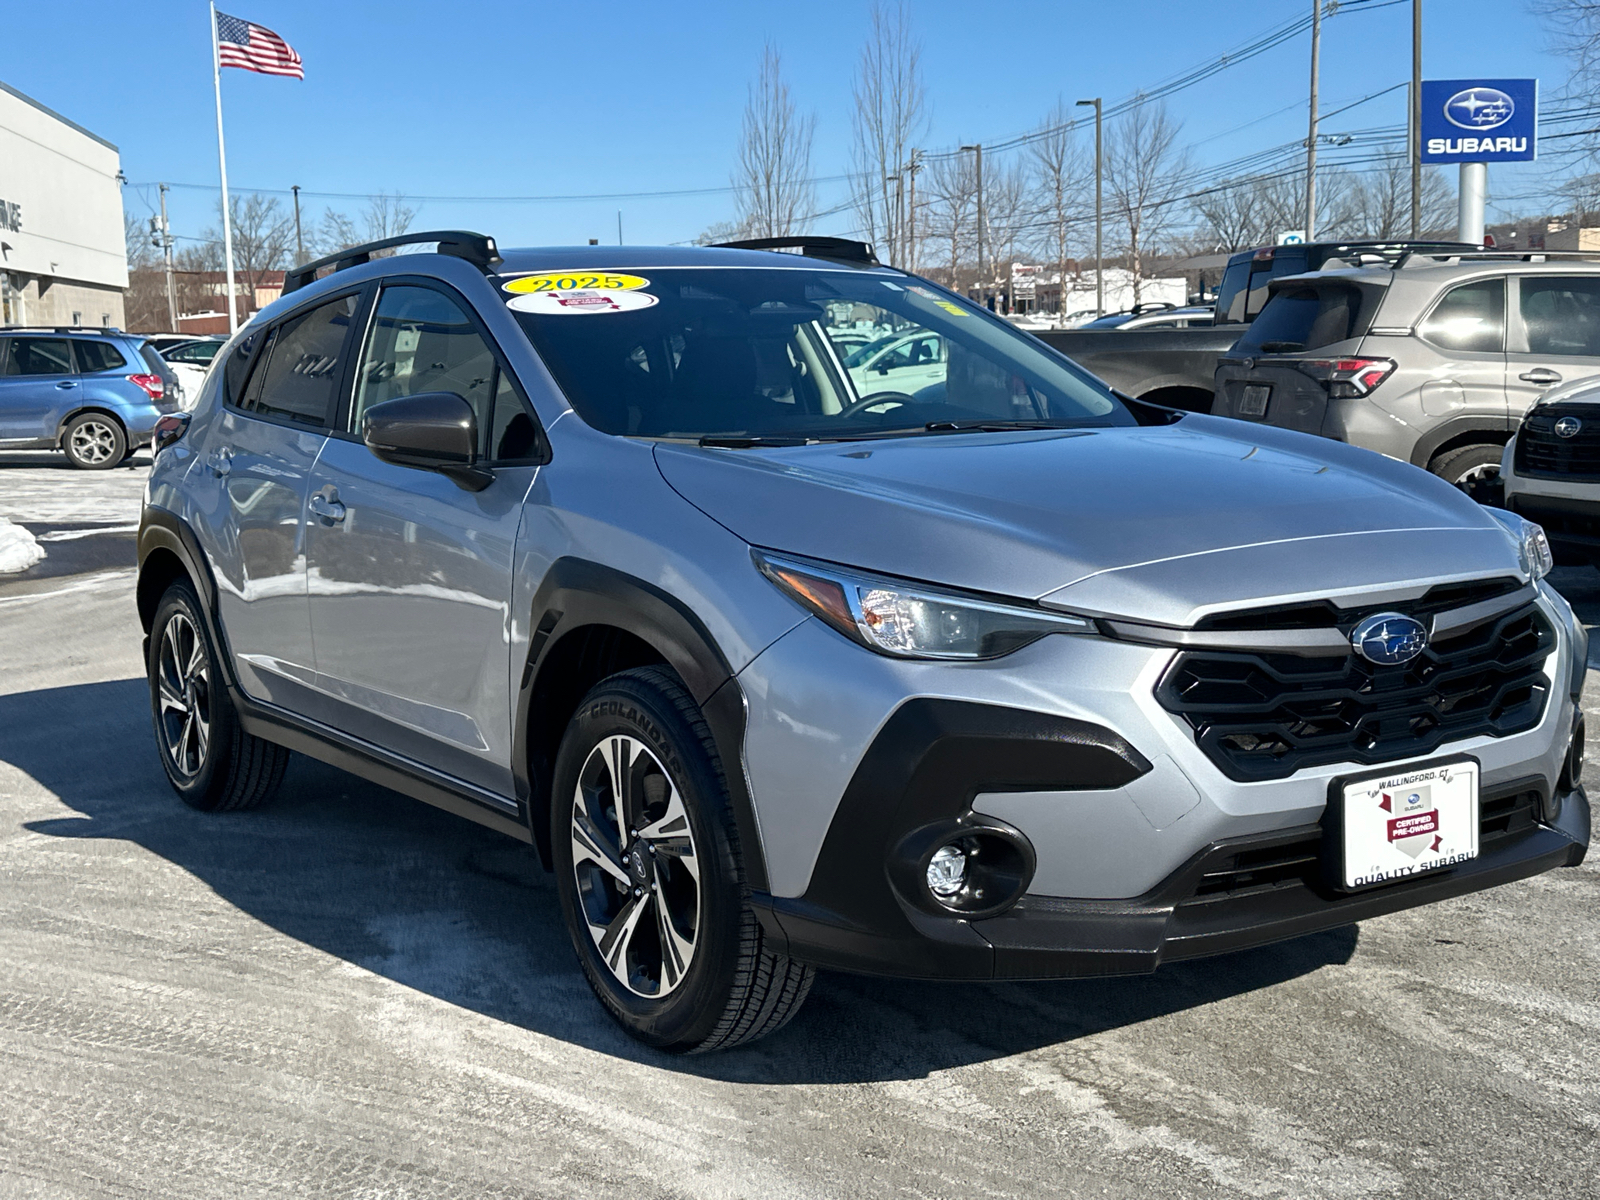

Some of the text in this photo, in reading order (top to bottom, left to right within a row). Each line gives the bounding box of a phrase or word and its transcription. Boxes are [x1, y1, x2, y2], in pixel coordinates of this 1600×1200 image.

[1427, 137, 1527, 154] SUBARU
[532, 276, 624, 292] 2025
[1392, 822, 1435, 836] PRE-OWNED
[1396, 815, 1432, 828] CERTIFIED
[1354, 850, 1475, 886] QUALITY SUBARU
